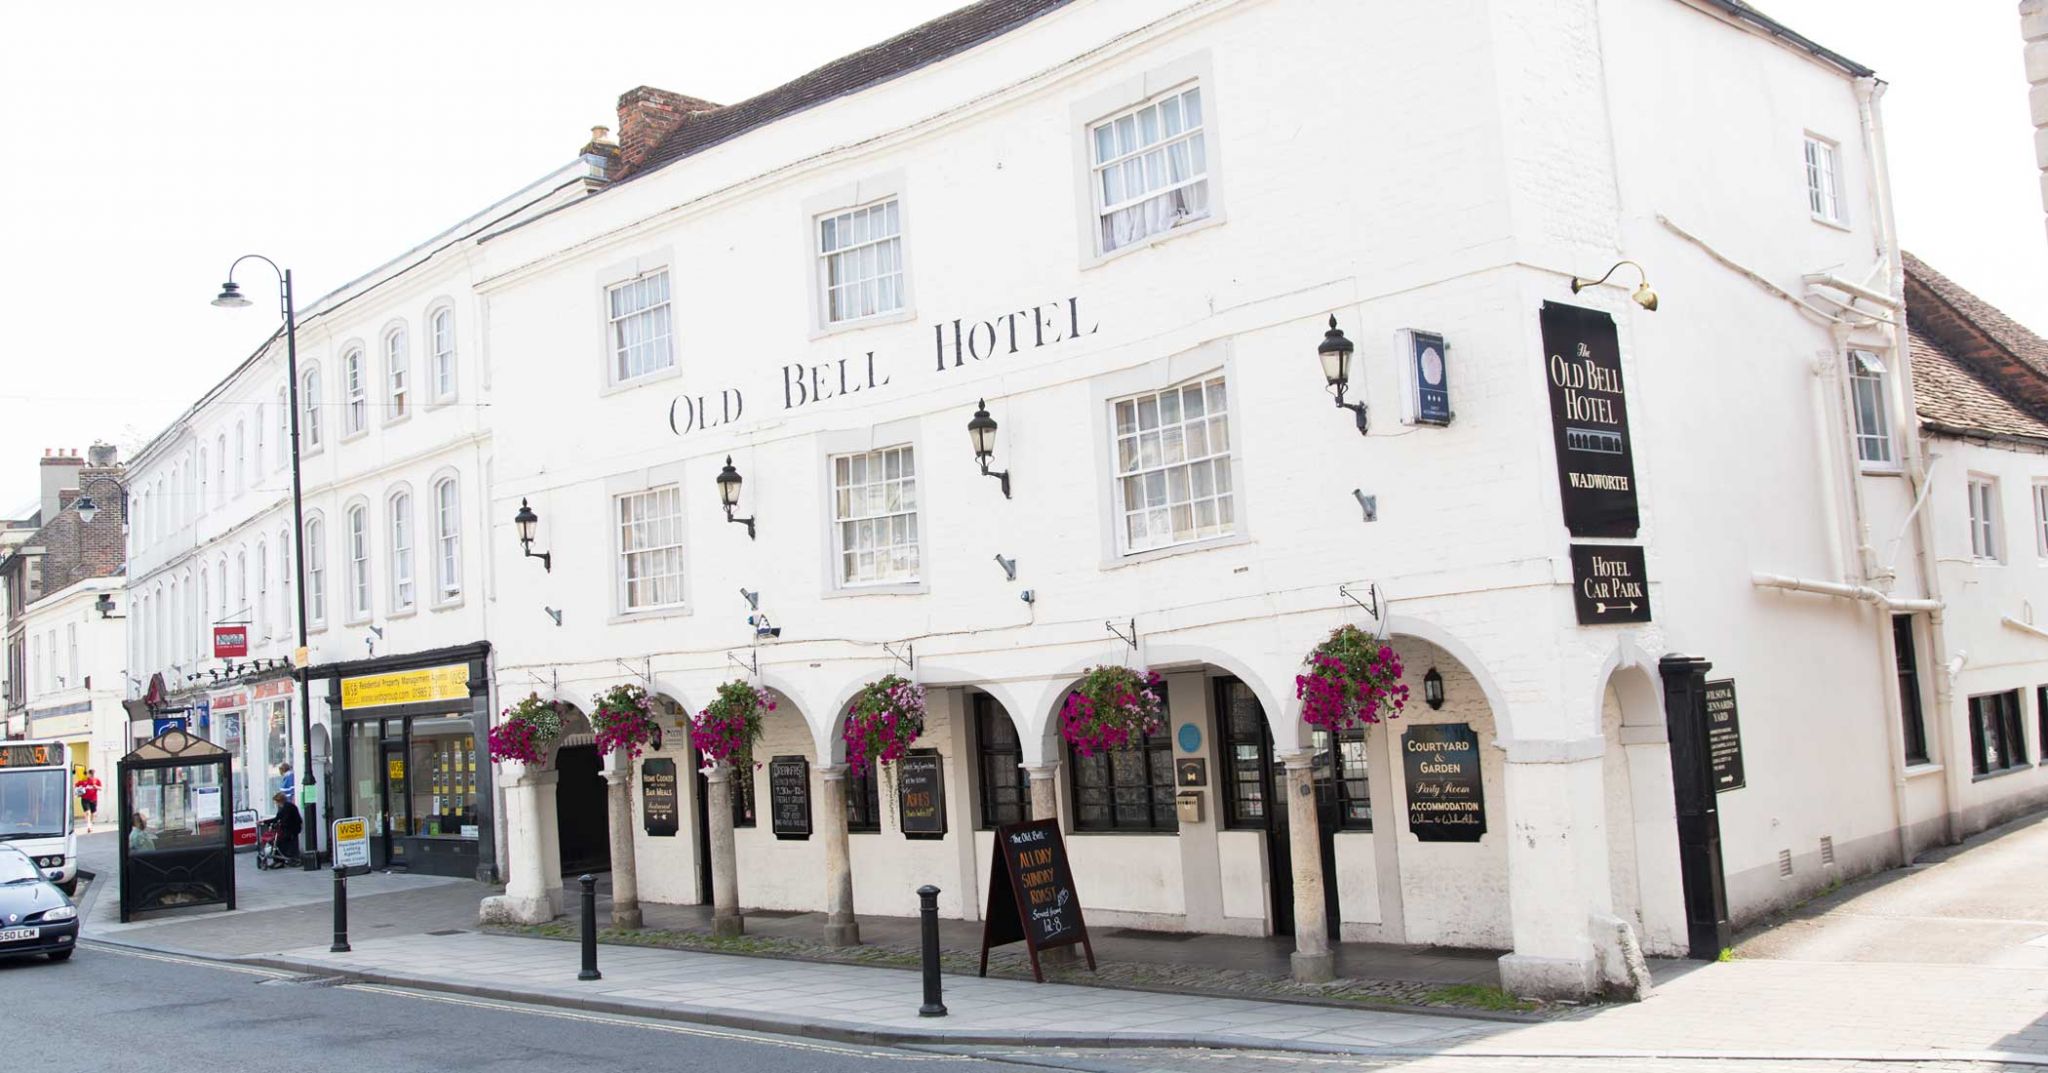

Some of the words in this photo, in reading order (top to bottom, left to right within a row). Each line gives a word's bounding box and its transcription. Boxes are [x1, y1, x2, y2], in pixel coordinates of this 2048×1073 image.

[1576, 342, 1591, 359] The
[669, 388, 744, 436] OLD
[783, 351, 890, 410] BELL
[933, 296, 1099, 372] HOTEL
[1551, 354, 1585, 388] OLD
[1585, 360, 1623, 394] BELL
[1564, 388, 1618, 425] HOTEL
[1569, 472, 1629, 492] WADWORTH
[1592, 556, 1631, 578] HOTEL
[1584, 578, 1609, 598] CAR
[1612, 577, 1643, 598] PARK
[1408, 740, 1470, 752] COURTYARD
[1434, 753, 1446, 763] &
[1420, 762, 1461, 774] GARDEN
[656, 773, 674, 782] COOKED
[645, 788, 656, 796] BAR
[656, 788, 672, 796] MEALS
[1416, 782, 1441, 797] Party
[1442, 782, 1470, 794] Room
[1410, 802, 1479, 812] ACCOMMODATION
[340, 823, 362, 834] WSB
[1011, 833, 1022, 844] The
[1021, 831, 1033, 843] Old
[1020, 851, 1034, 868] ALL
[1034, 847, 1053, 866] DAY
[1022, 867, 1055, 888] SUNDAY
[1029, 886, 1057, 905] ROAST
[17, 929, 35, 939] LCM
